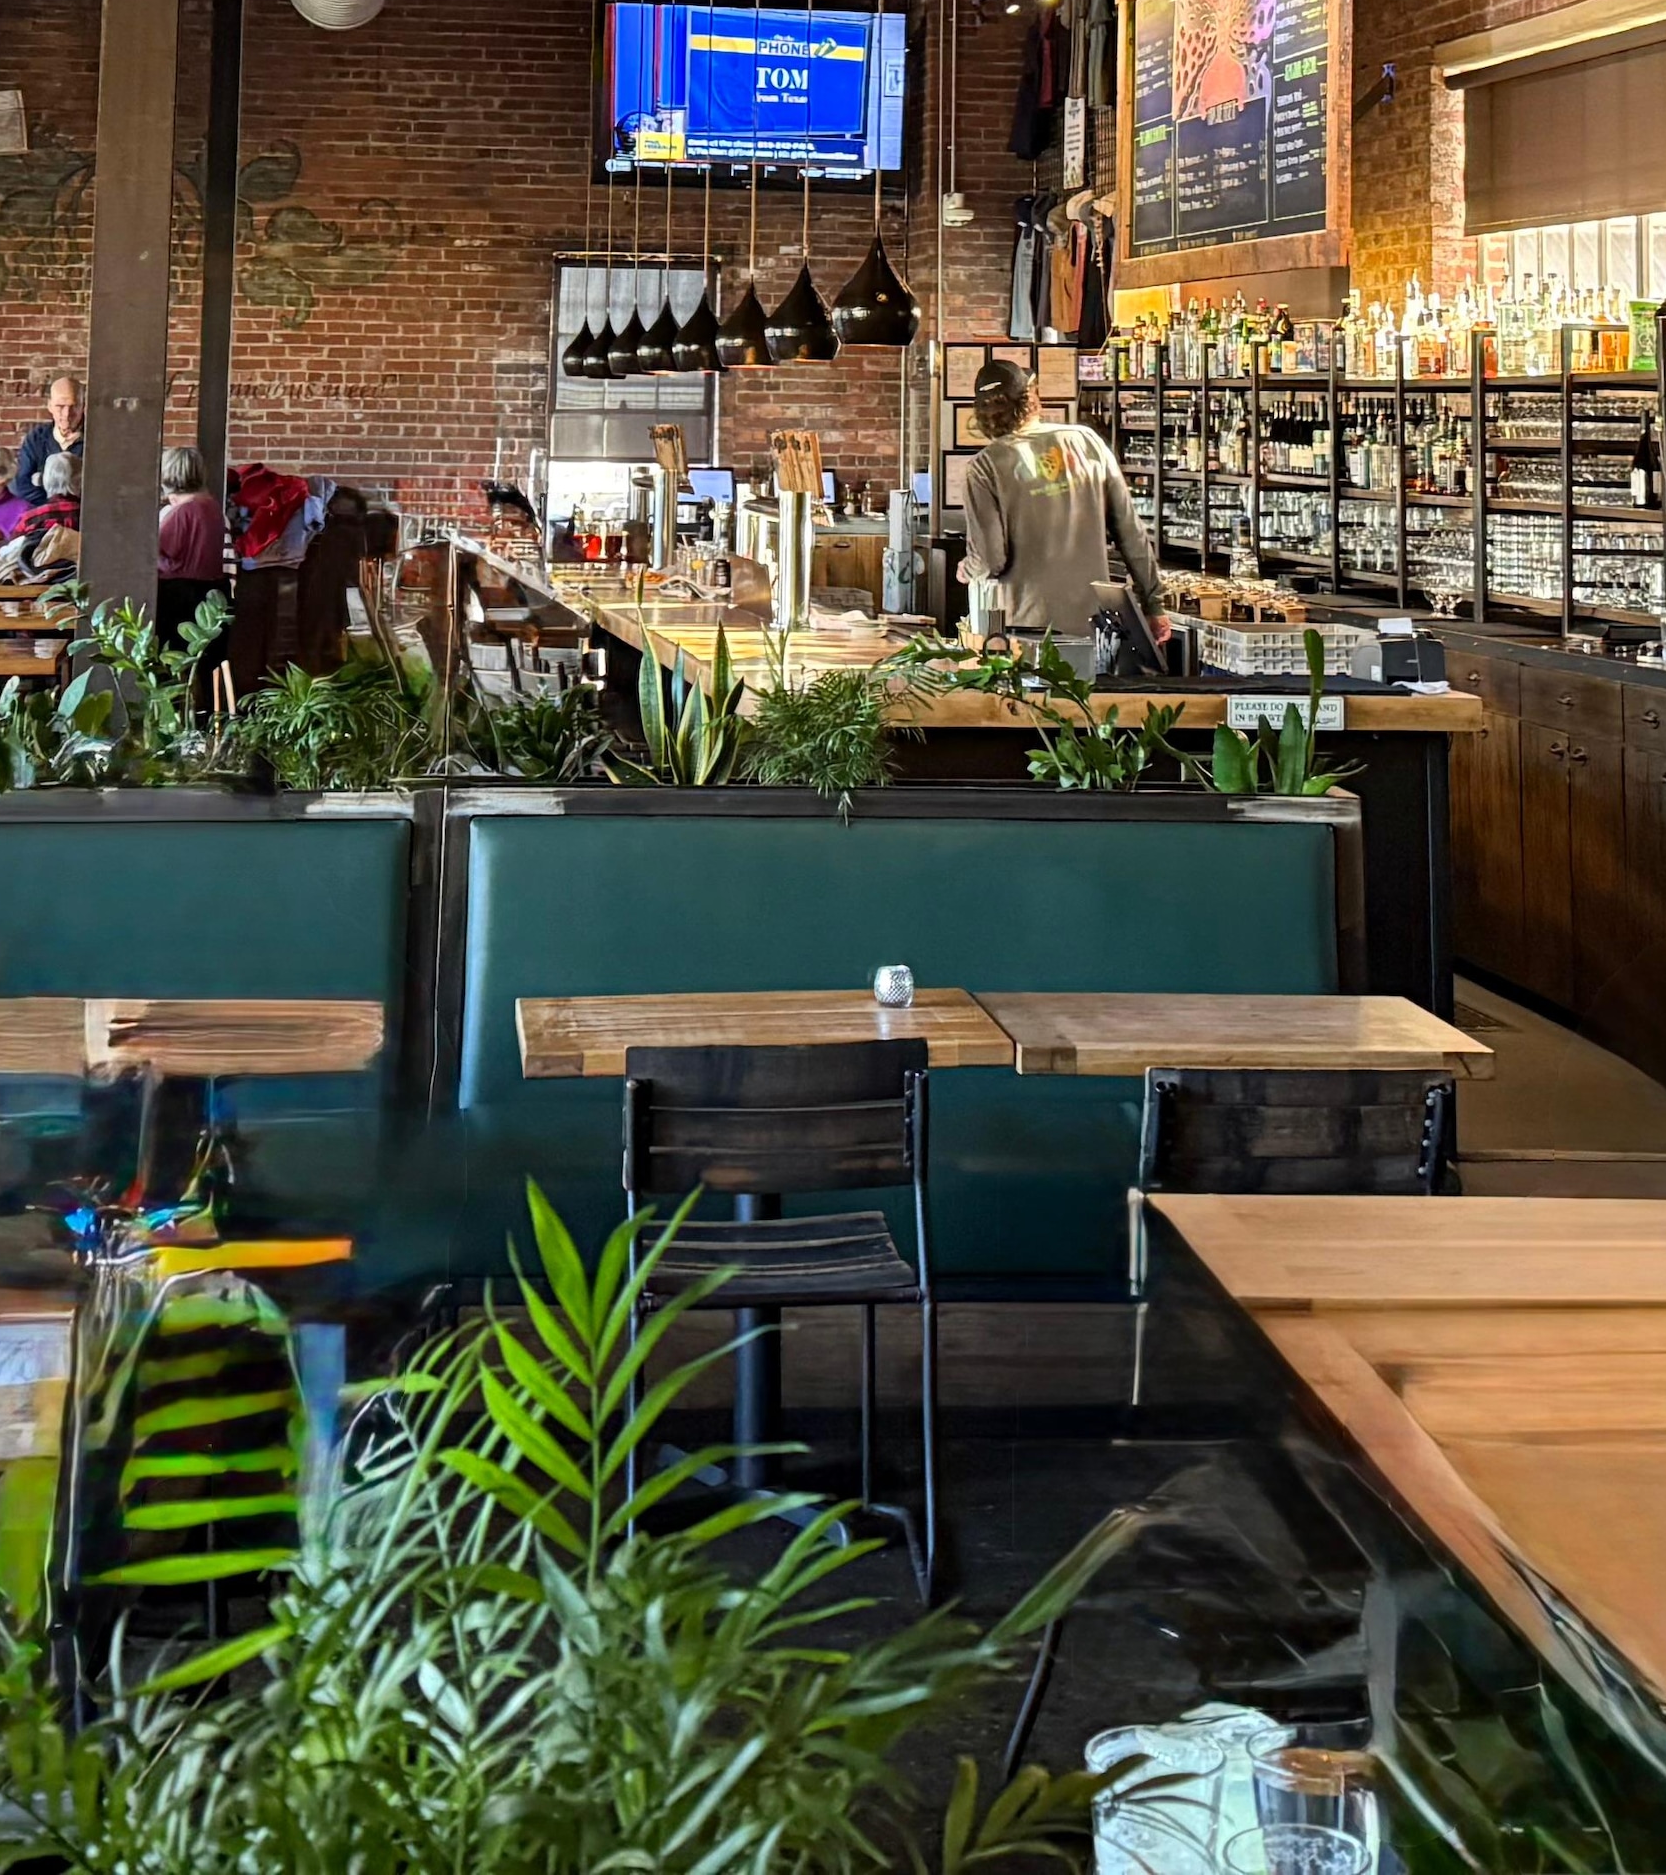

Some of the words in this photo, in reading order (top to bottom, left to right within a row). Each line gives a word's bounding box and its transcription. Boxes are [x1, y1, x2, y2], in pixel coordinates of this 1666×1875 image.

[758, 42, 809, 56] PHONE
[756, 67, 809, 90] TOM
[1235, 702, 1268, 711] PLEASE
[1270, 702, 1284, 711] DO
